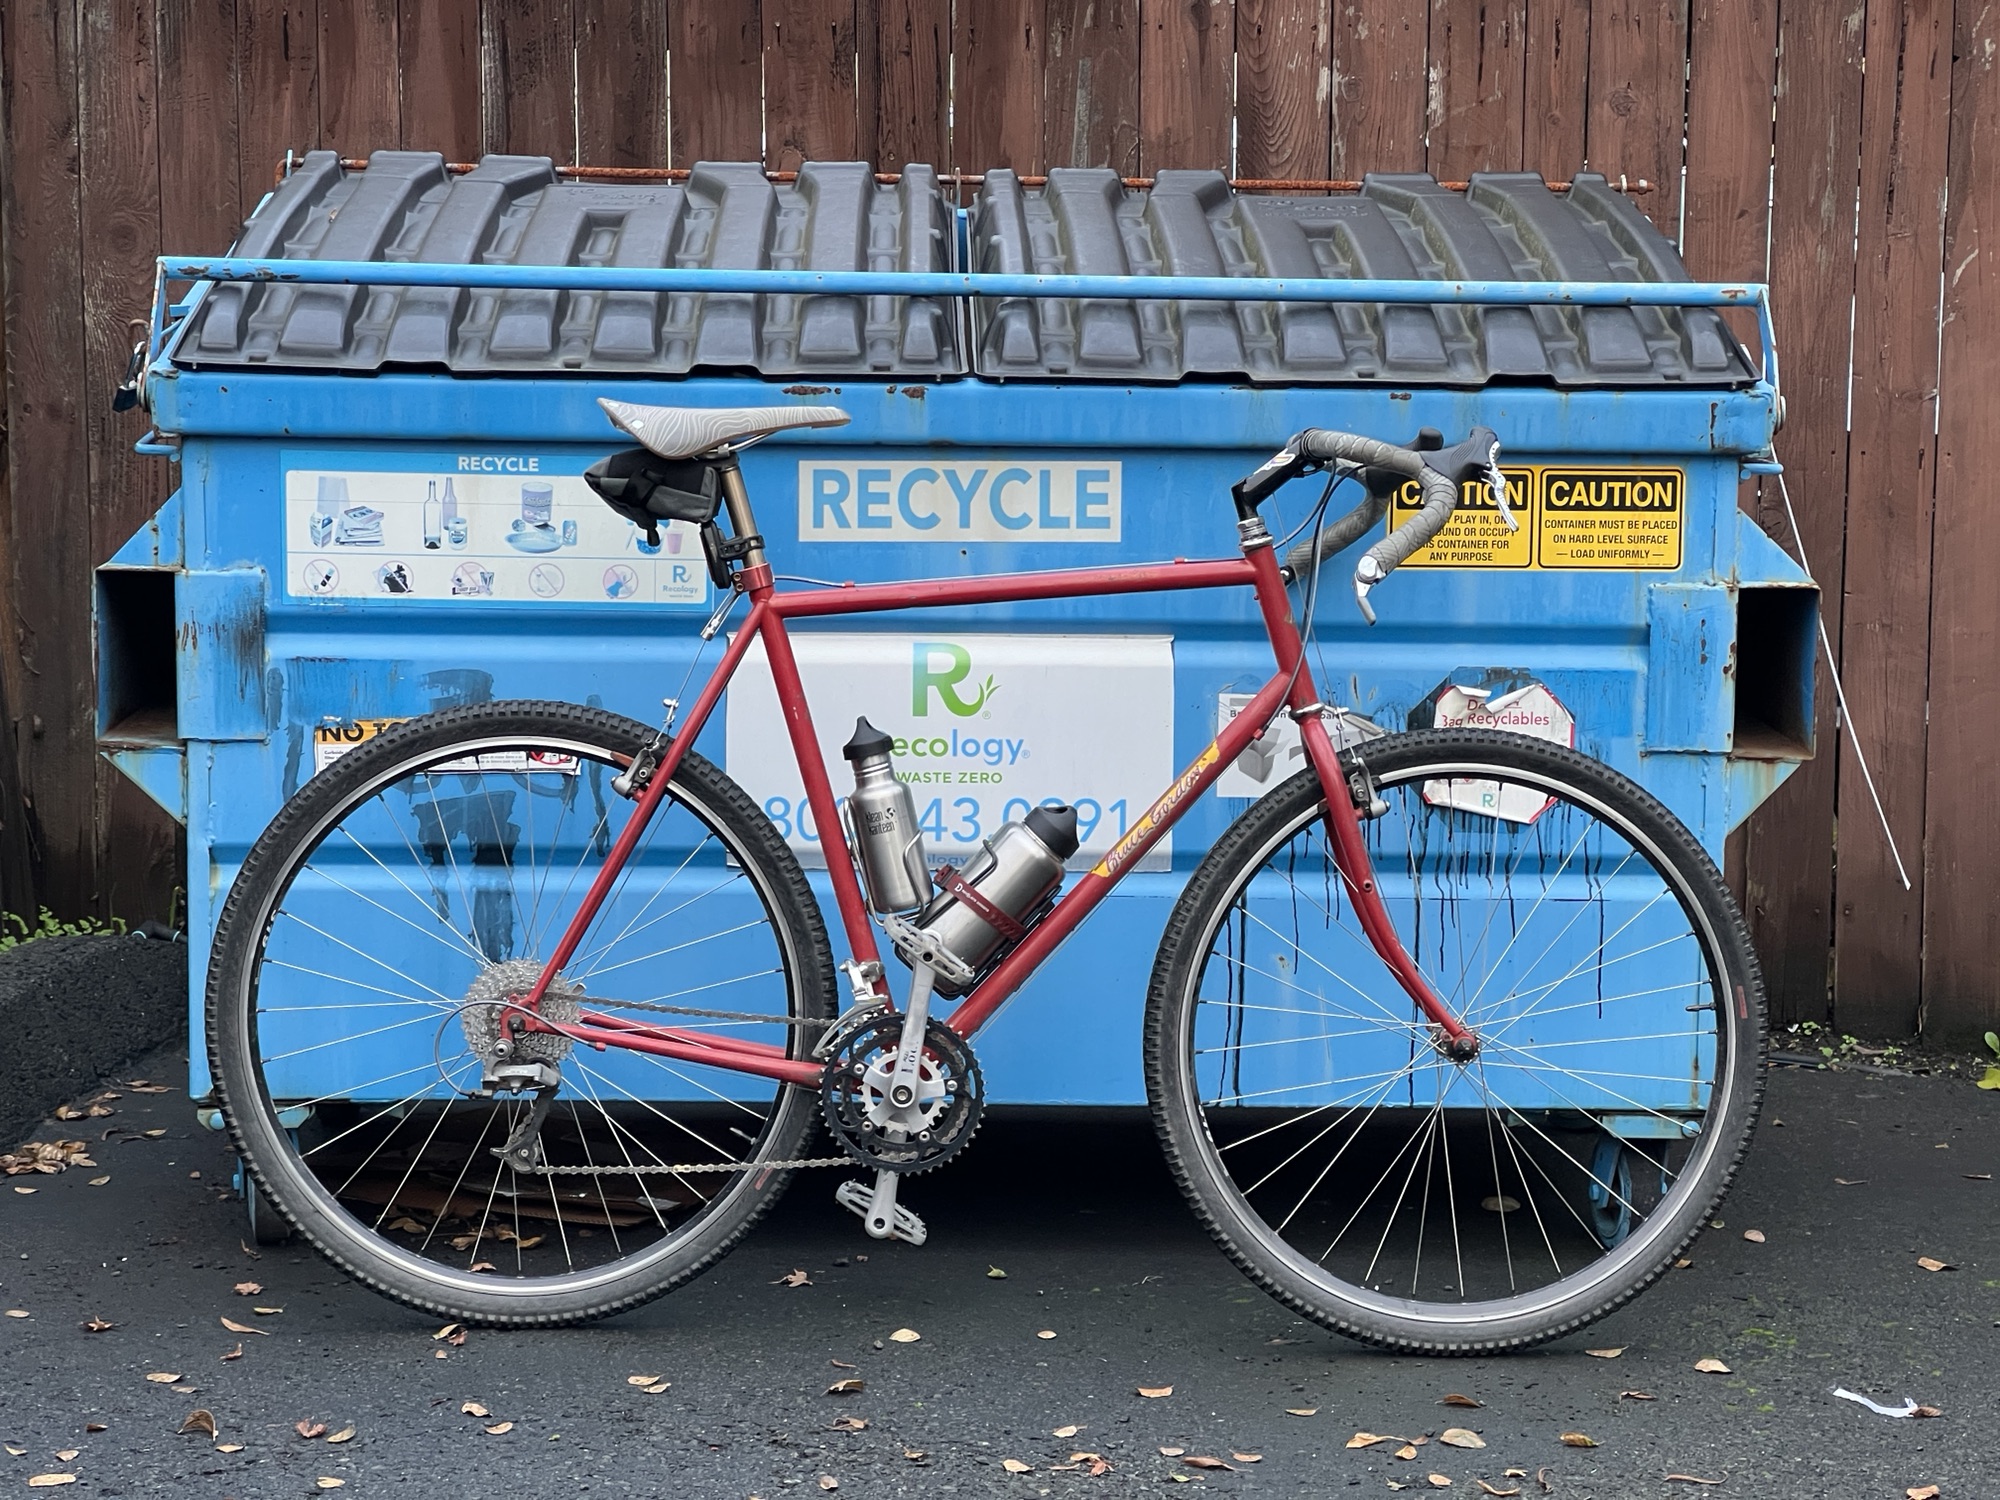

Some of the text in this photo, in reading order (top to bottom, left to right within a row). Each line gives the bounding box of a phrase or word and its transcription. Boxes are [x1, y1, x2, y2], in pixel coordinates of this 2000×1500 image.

[458, 456, 539, 472] RECYCLE
[812, 467, 1111, 530] RECYCLE
[1401, 480, 1523, 506] CTION
[1550, 481, 1673, 507] CAUTION
[1454, 515, 1477, 524] PLAY
[1544, 520, 1678, 530] CONTAINER MUST BE PLACED
[1464, 527, 1477, 537] OR
[1553, 534, 1669, 544] ON HARD LEVEL SURFACE
[1437, 540, 1488, 549] CONTAINER
[1492, 540, 1510, 549] FOR
[1429, 552, 1493, 561] ANY PURPOSE
[1570, 549, 1650, 559] LOAD UNIFORMLY
[1467, 711, 1550, 729] Recyclables
[322, 722, 364, 742] NO
[888, 728, 1024, 766] ecology
[896, 772, 1003, 784] WASTE ZERO
[1106, 827, 1150, 873] Bruce
